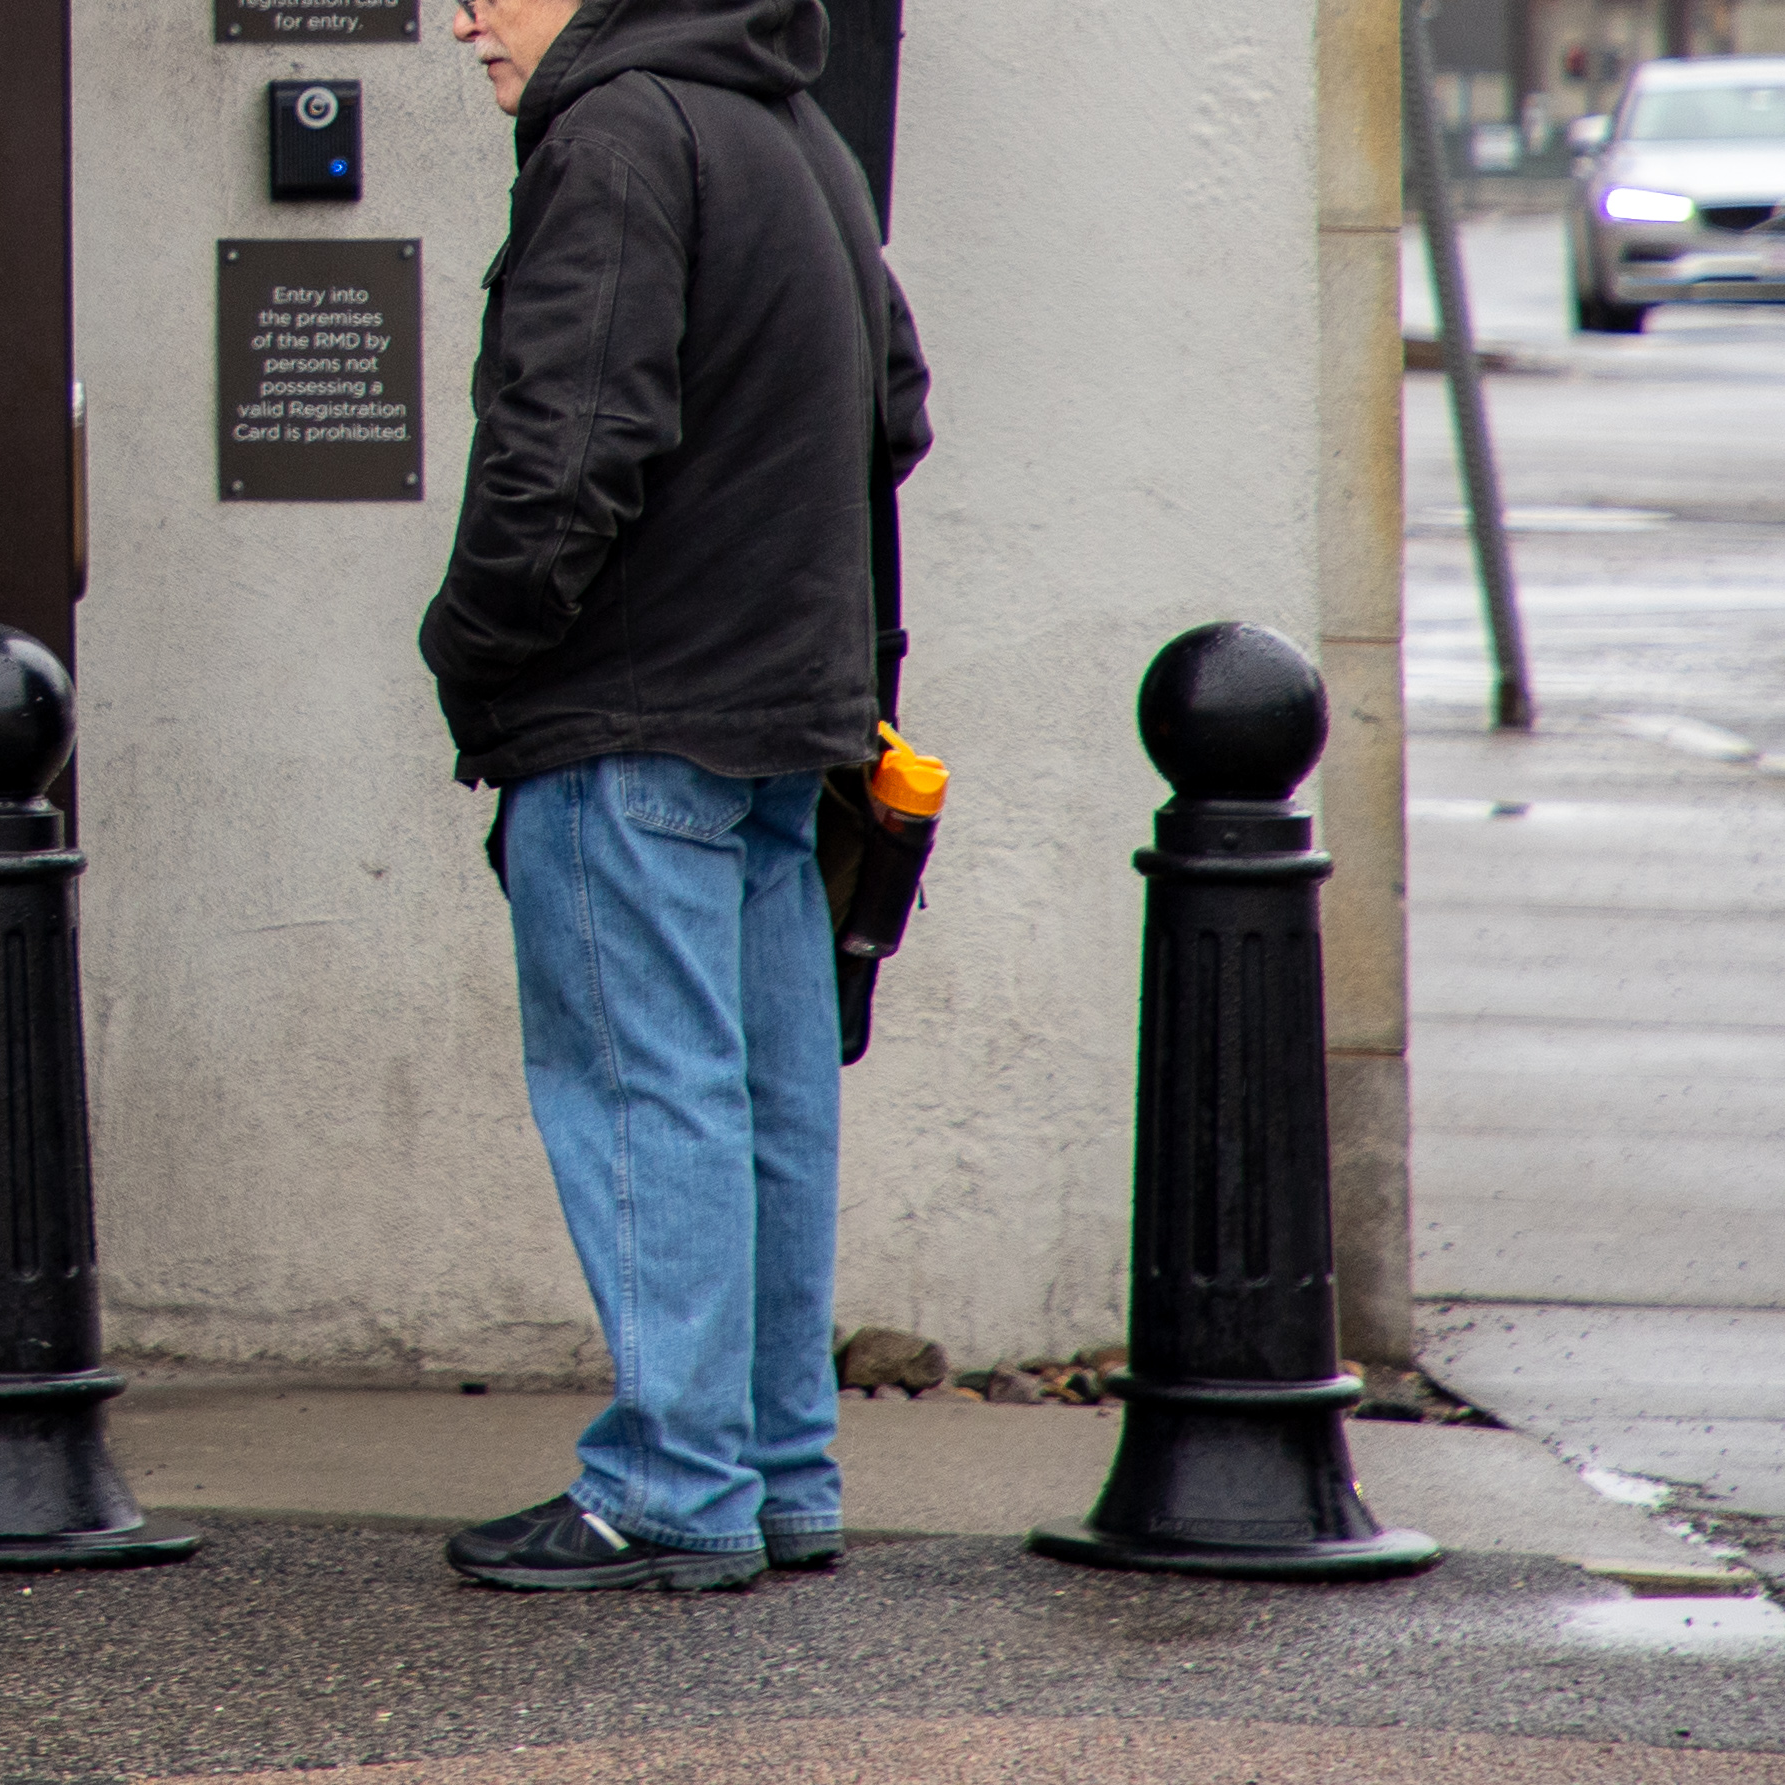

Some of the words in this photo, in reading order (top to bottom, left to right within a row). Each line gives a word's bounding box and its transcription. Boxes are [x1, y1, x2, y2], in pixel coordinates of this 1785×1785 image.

[275, 13, 302, 31] for
[307, 13, 364, 33] entry.
[273, 286, 326, 307] Entry
[331, 287, 369, 304] into
[259, 310, 291, 327] the
[296, 309, 383, 329] premises
[251, 332, 273, 350] of
[277, 333, 309, 349] the
[313, 332, 361, 350] RMD
[365, 332, 391, 352] by
[263, 358, 341, 374] persons
[345, 357, 378, 372] not
[260, 378, 366, 398] possessing
[371, 381, 383, 395] a
[237, 401, 284, 418] valid
[288, 401, 407, 421] Registration
[233, 423, 280, 441] Card
[284, 424, 301, 441] is
[305, 423, 411, 443] prohibited.
